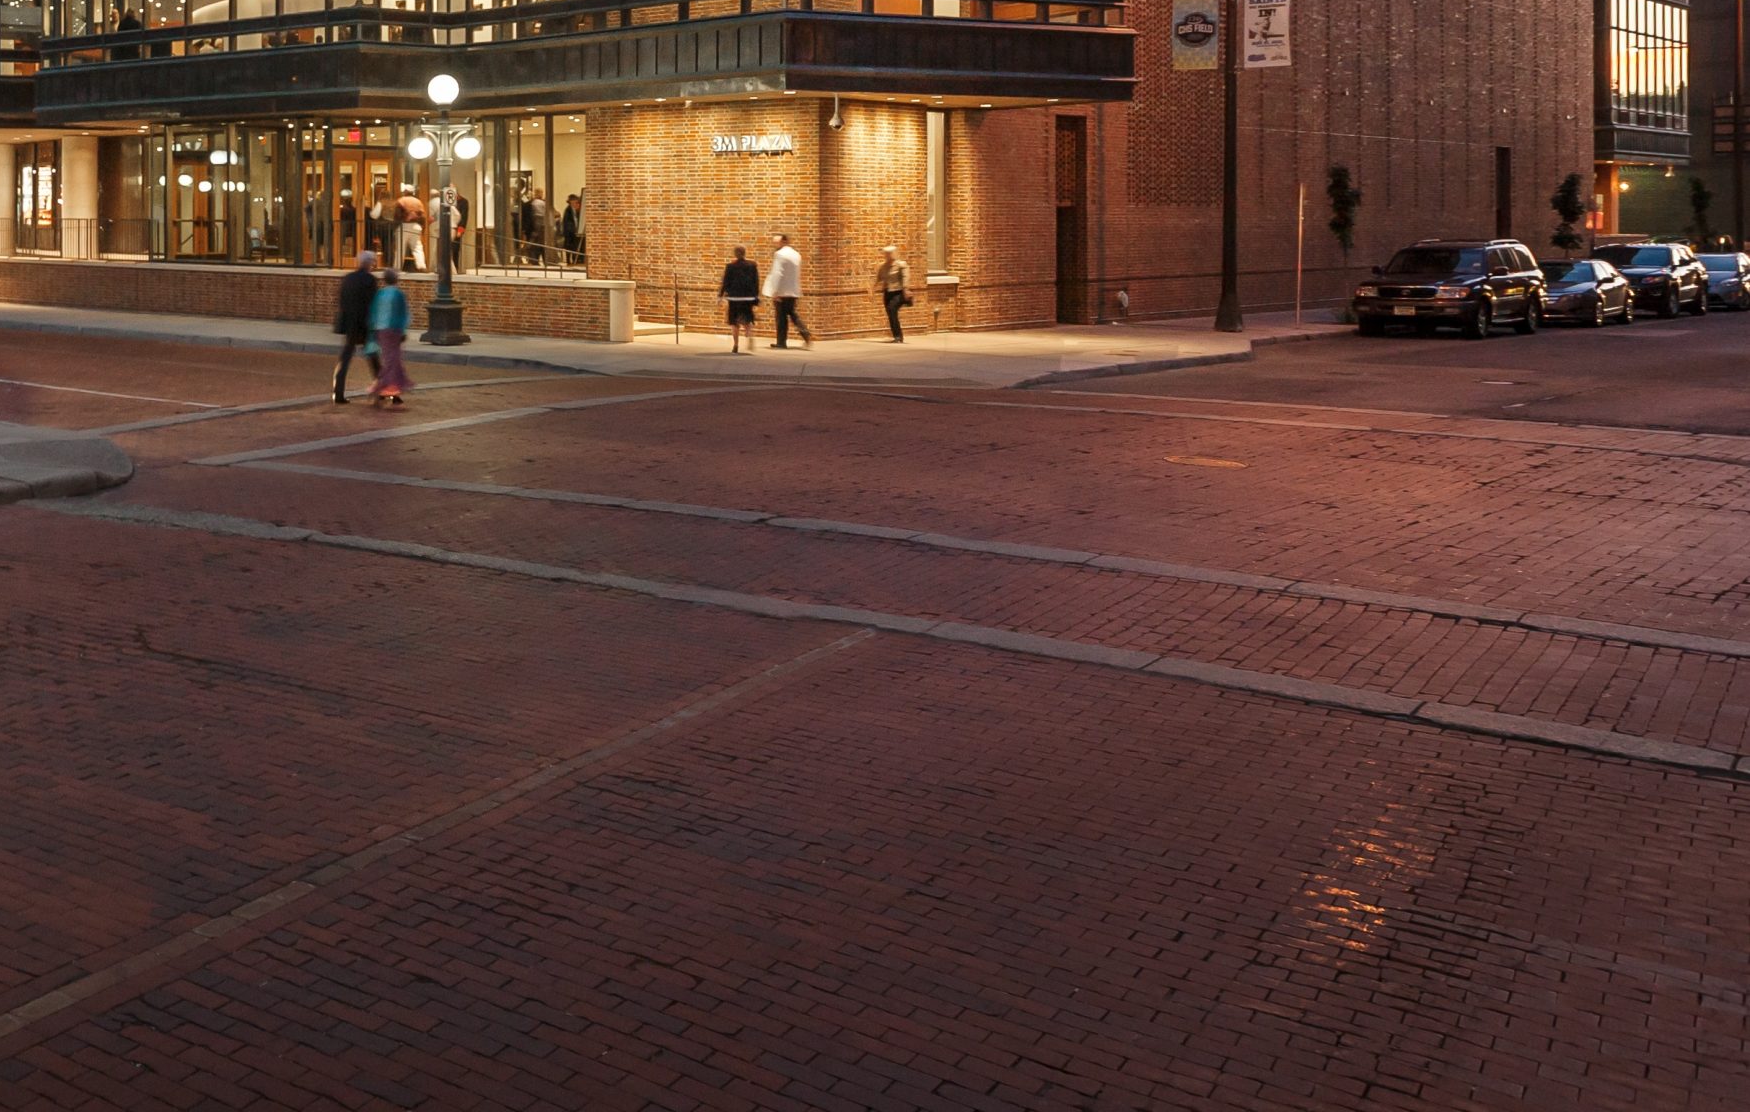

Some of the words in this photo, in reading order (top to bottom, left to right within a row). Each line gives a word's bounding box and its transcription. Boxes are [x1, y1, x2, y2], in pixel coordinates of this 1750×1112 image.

[1194, 24, 1213, 33] FIELD
[712, 135, 737, 151] 3M
[740, 135, 792, 151] PLAZA
